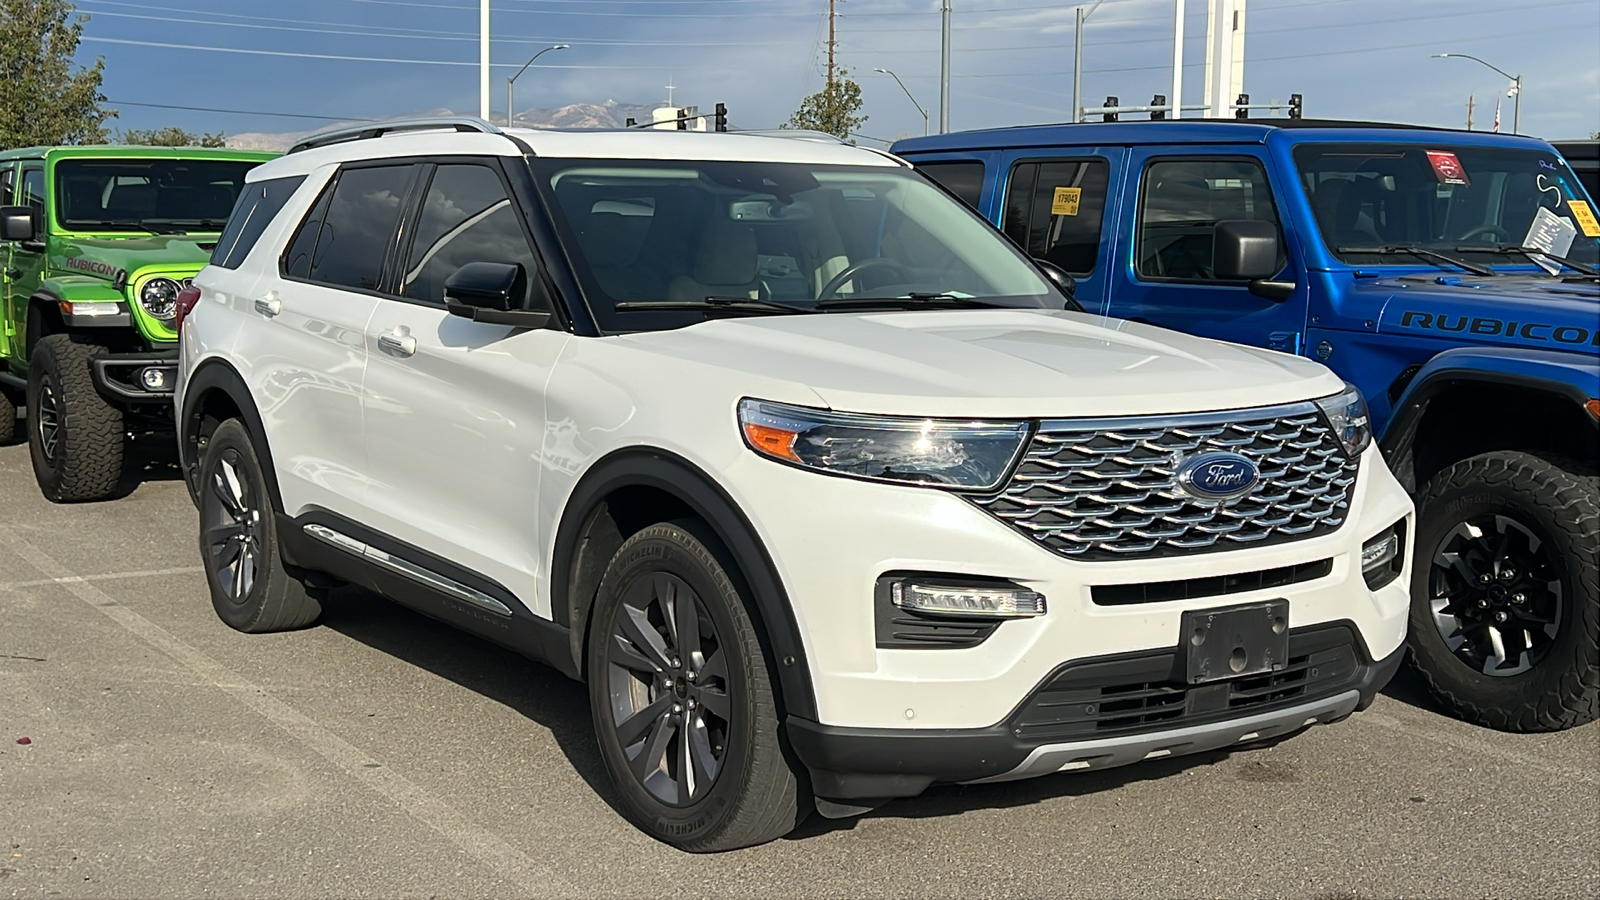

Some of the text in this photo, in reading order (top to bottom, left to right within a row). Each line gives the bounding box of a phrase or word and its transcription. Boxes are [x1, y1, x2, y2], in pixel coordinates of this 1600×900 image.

[1058, 194, 1078, 203] 179043
[66, 257, 117, 276] RUBICON
[1401, 311, 1599, 346] RUBICO
[1206, 464, 1245, 487] Ford
[620, 546, 662, 570] MICHELIN
[658, 817, 705, 836] MICHELIN
